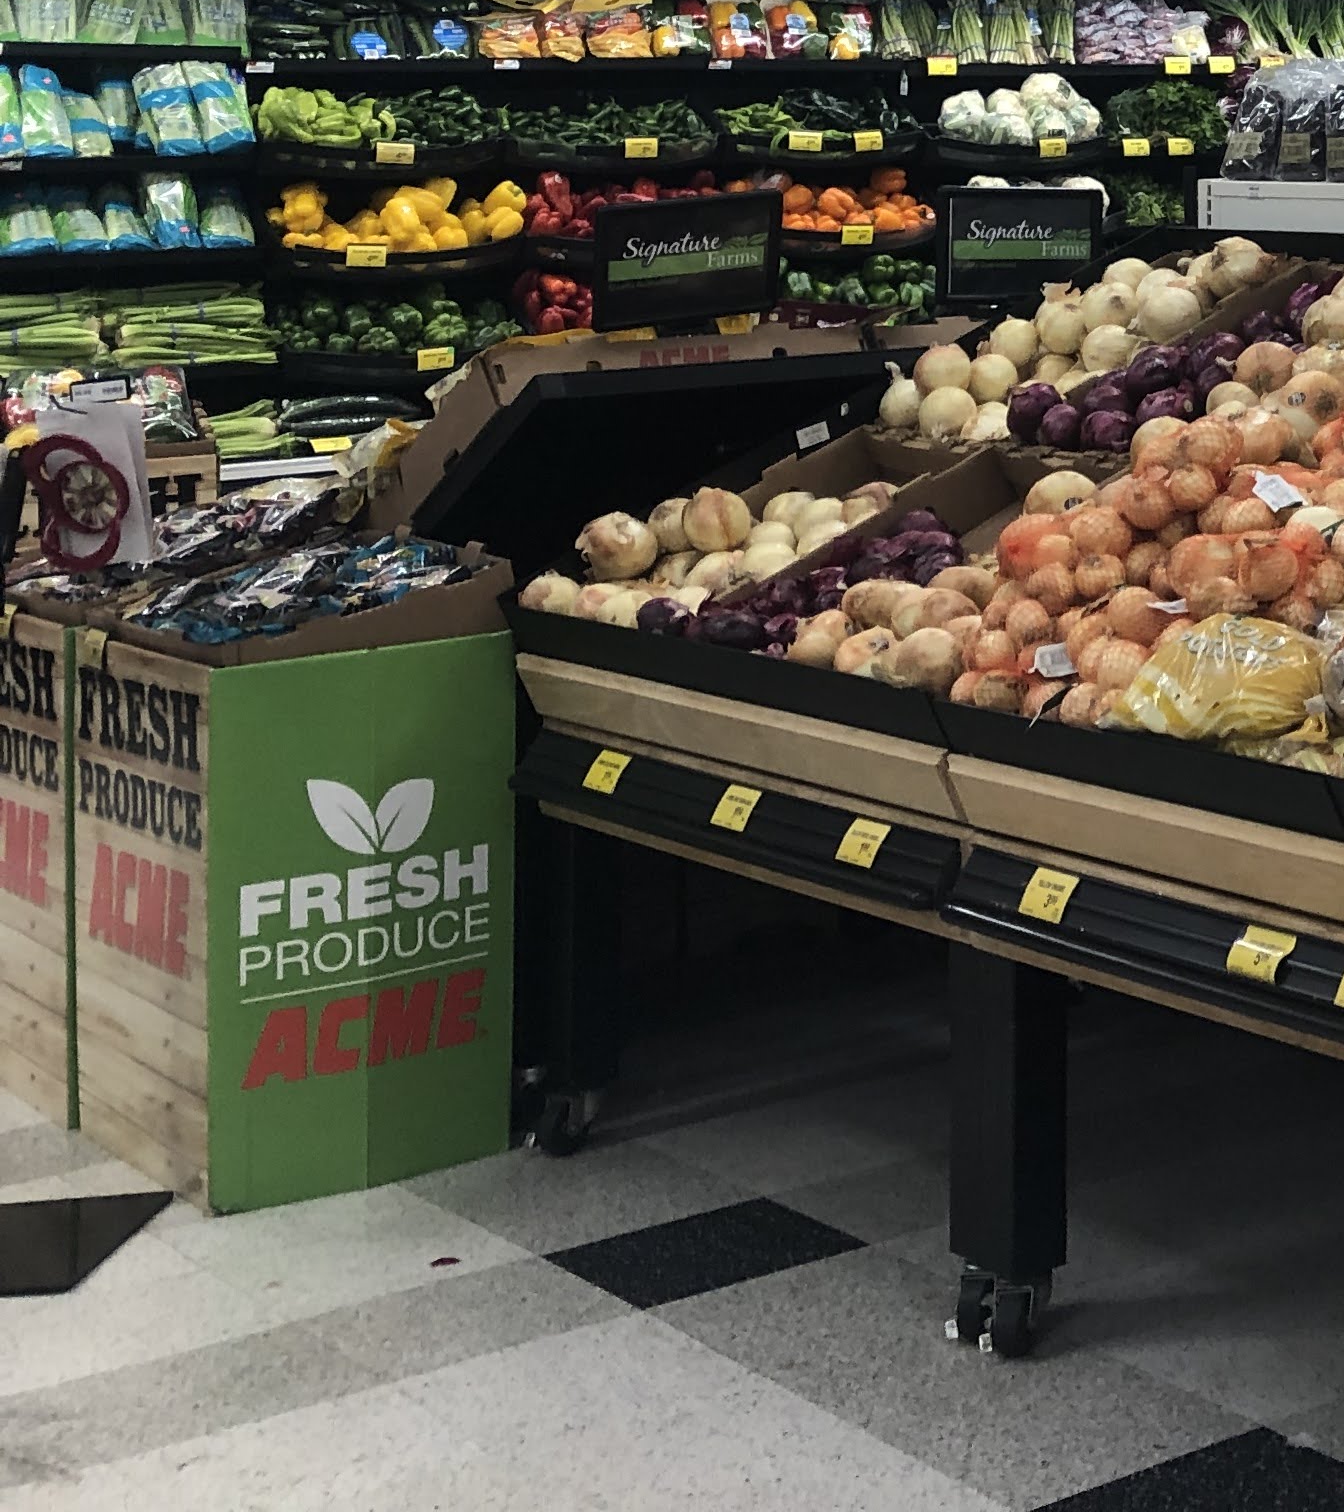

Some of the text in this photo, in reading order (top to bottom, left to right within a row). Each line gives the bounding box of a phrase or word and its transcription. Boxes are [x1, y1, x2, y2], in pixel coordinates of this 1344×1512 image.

[622, 232, 722, 265] Signature
[707, 250, 759, 268] Farms
[966, 219, 1054, 248] Signature
[1041, 241, 1088, 257] Farms
[78, 666, 201, 773] FRESH
[78, 758, 203, 852] PRODUCE
[88, 841, 190, 979] ACME
[239, 843, 489, 938] FRESH
[239, 902, 490, 987] PRODUCE
[241, 968, 486, 1090] ACME
